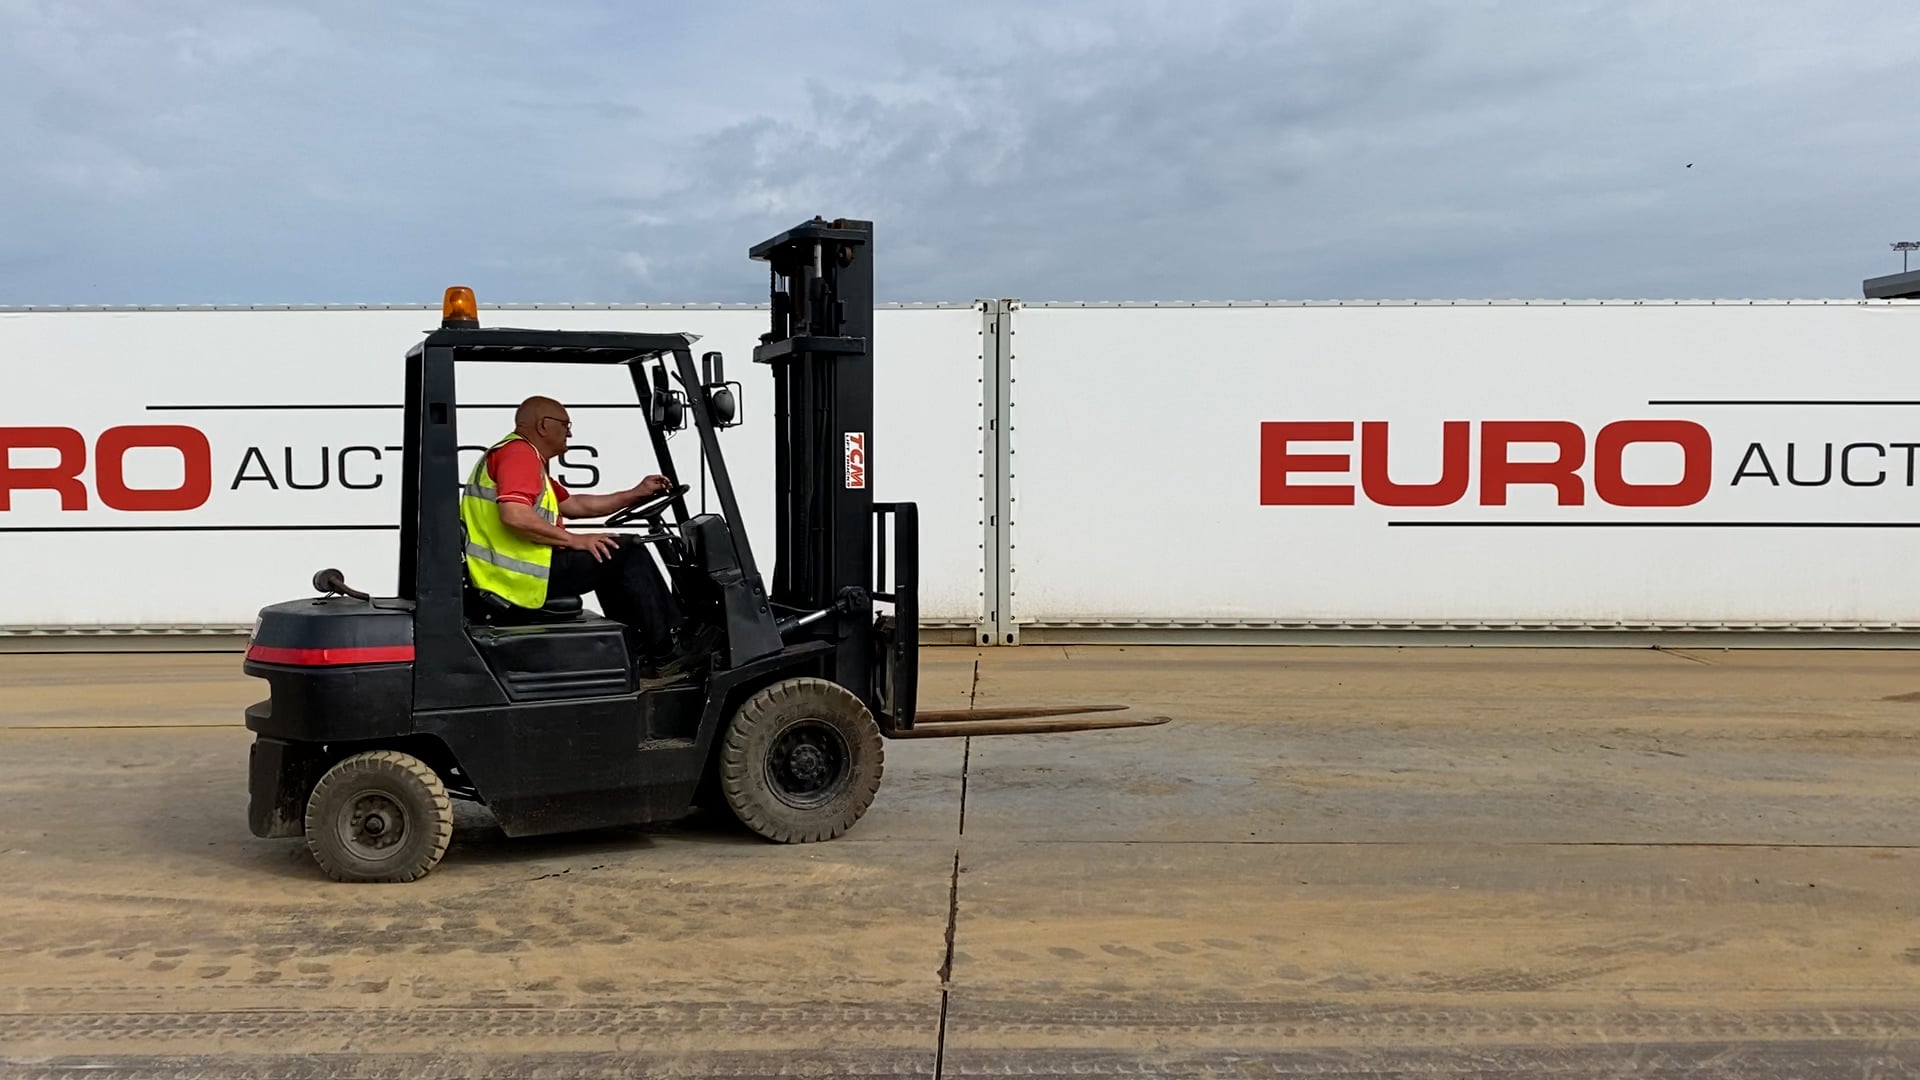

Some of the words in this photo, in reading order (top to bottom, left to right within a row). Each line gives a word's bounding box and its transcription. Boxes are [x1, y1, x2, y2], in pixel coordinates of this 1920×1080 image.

[230, 445, 600, 490] AUCS
[850, 434, 863, 487] TCM
[1259, 419, 1712, 508] EURO
[1730, 442, 1920, 487] AUCT
